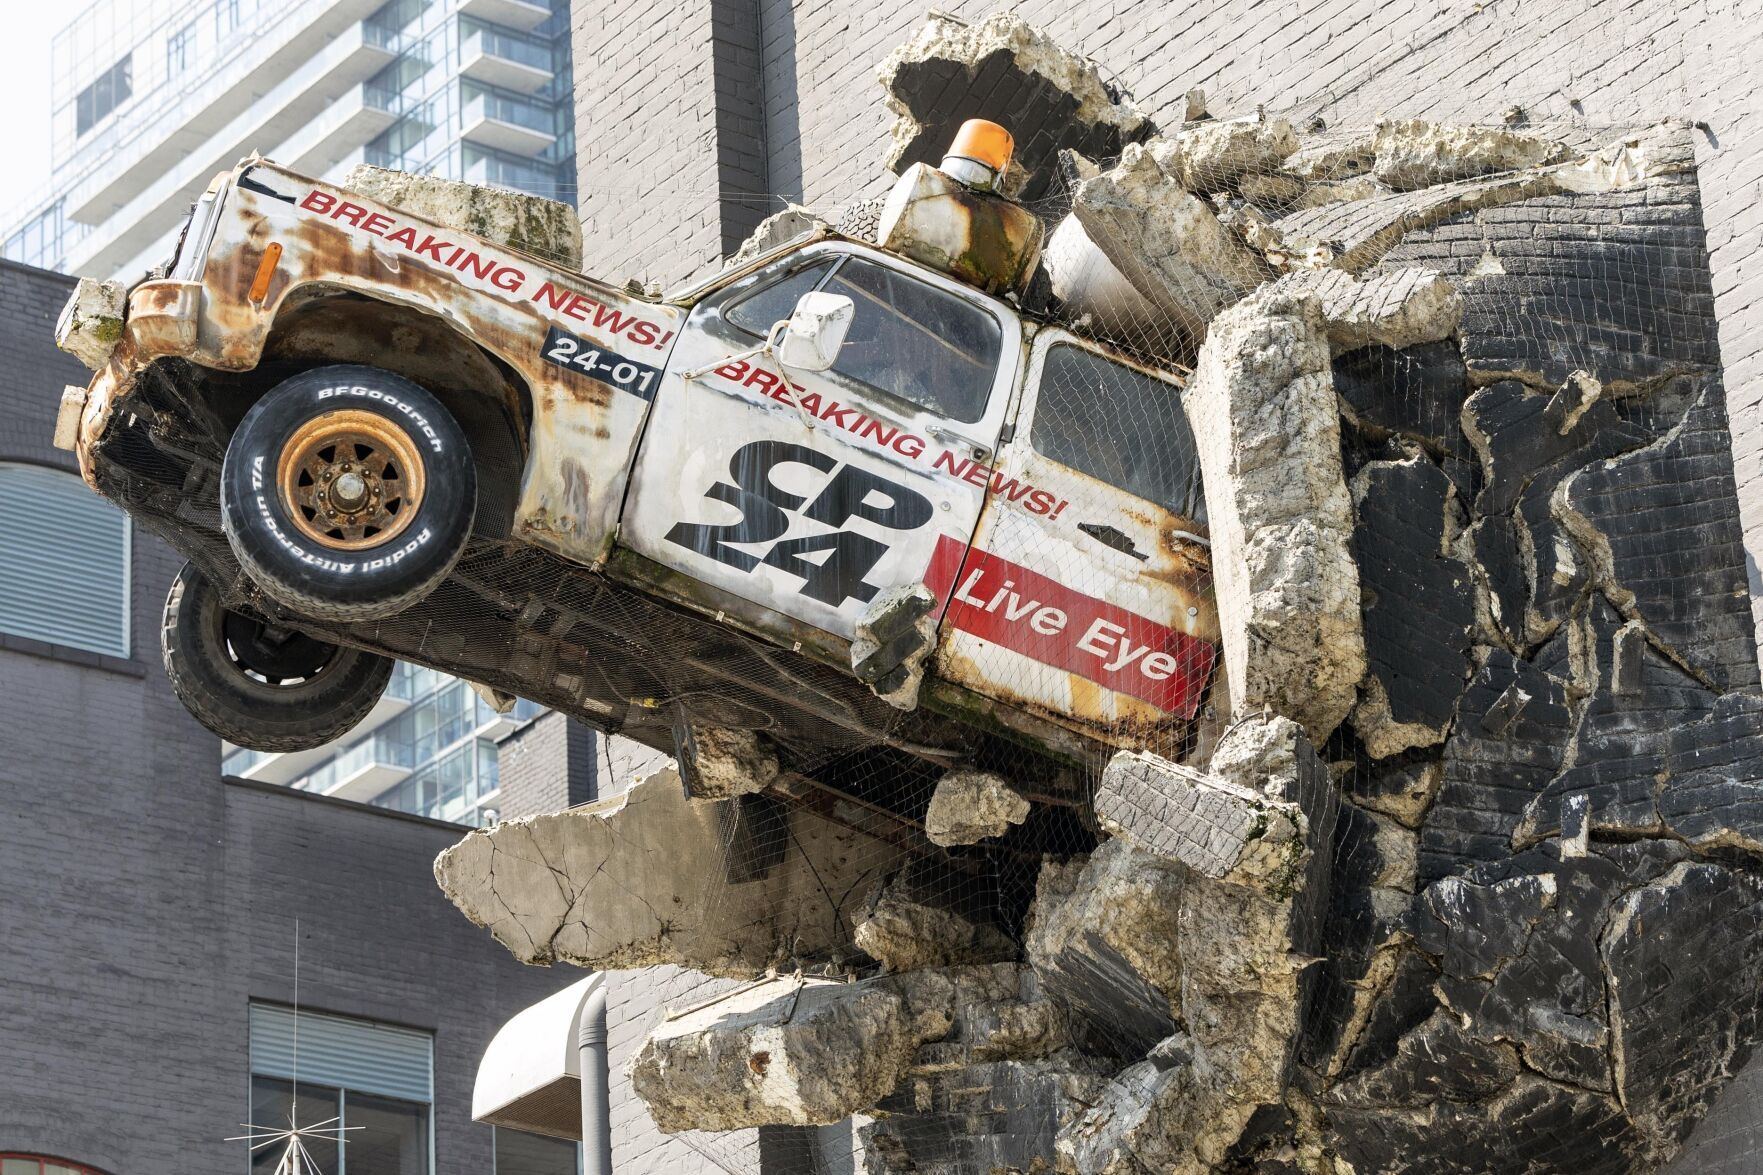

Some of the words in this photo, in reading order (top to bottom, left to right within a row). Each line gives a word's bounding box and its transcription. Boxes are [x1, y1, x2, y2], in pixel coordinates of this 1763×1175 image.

[300, 190, 526, 293] BREAKING
[533, 283, 675, 351] NEWS!
[549, 338, 655, 394] 24-01
[318, 386, 442, 453] BFGoodrich
[714, 360, 926, 460] BREAKING
[934, 450, 1069, 521] NEWS!
[252, 456, 265, 491] T/A
[729, 440, 933, 530] CP
[361, 528, 432, 573] Radial
[664, 481, 889, 608] 24
[954, 567, 1067, 636] Live
[1076, 617, 1177, 680] Eye
